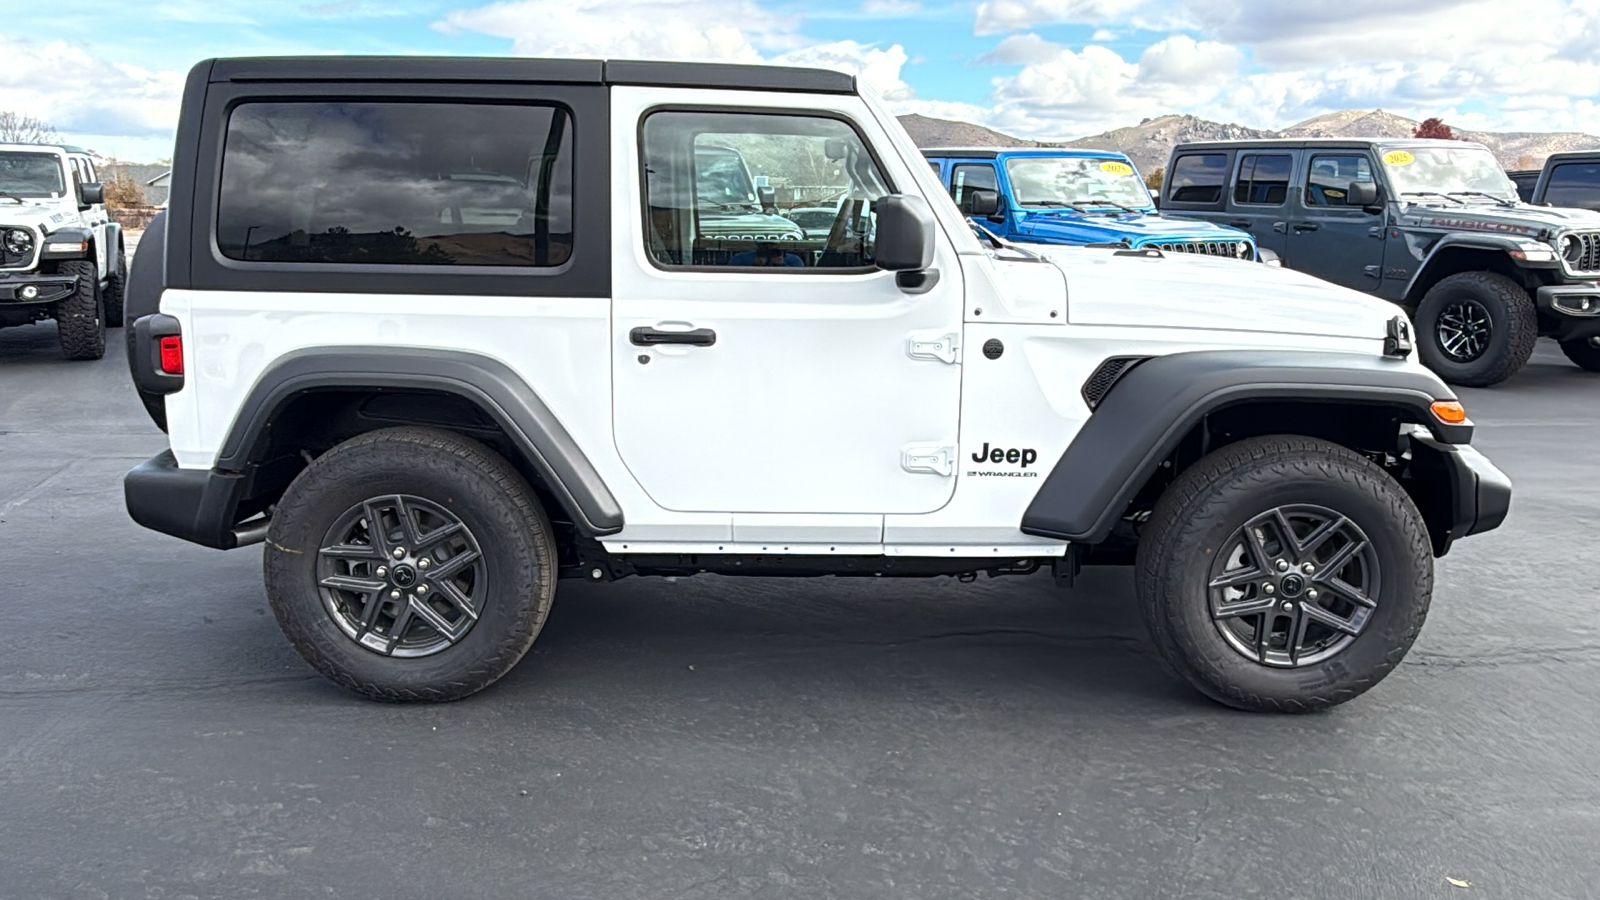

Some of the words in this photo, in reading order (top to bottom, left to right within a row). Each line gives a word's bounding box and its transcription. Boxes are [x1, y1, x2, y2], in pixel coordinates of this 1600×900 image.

[1389, 153, 1408, 163] 2025
[1431, 218, 1530, 233] RUBICON
[971, 442, 1037, 468] Jeep
